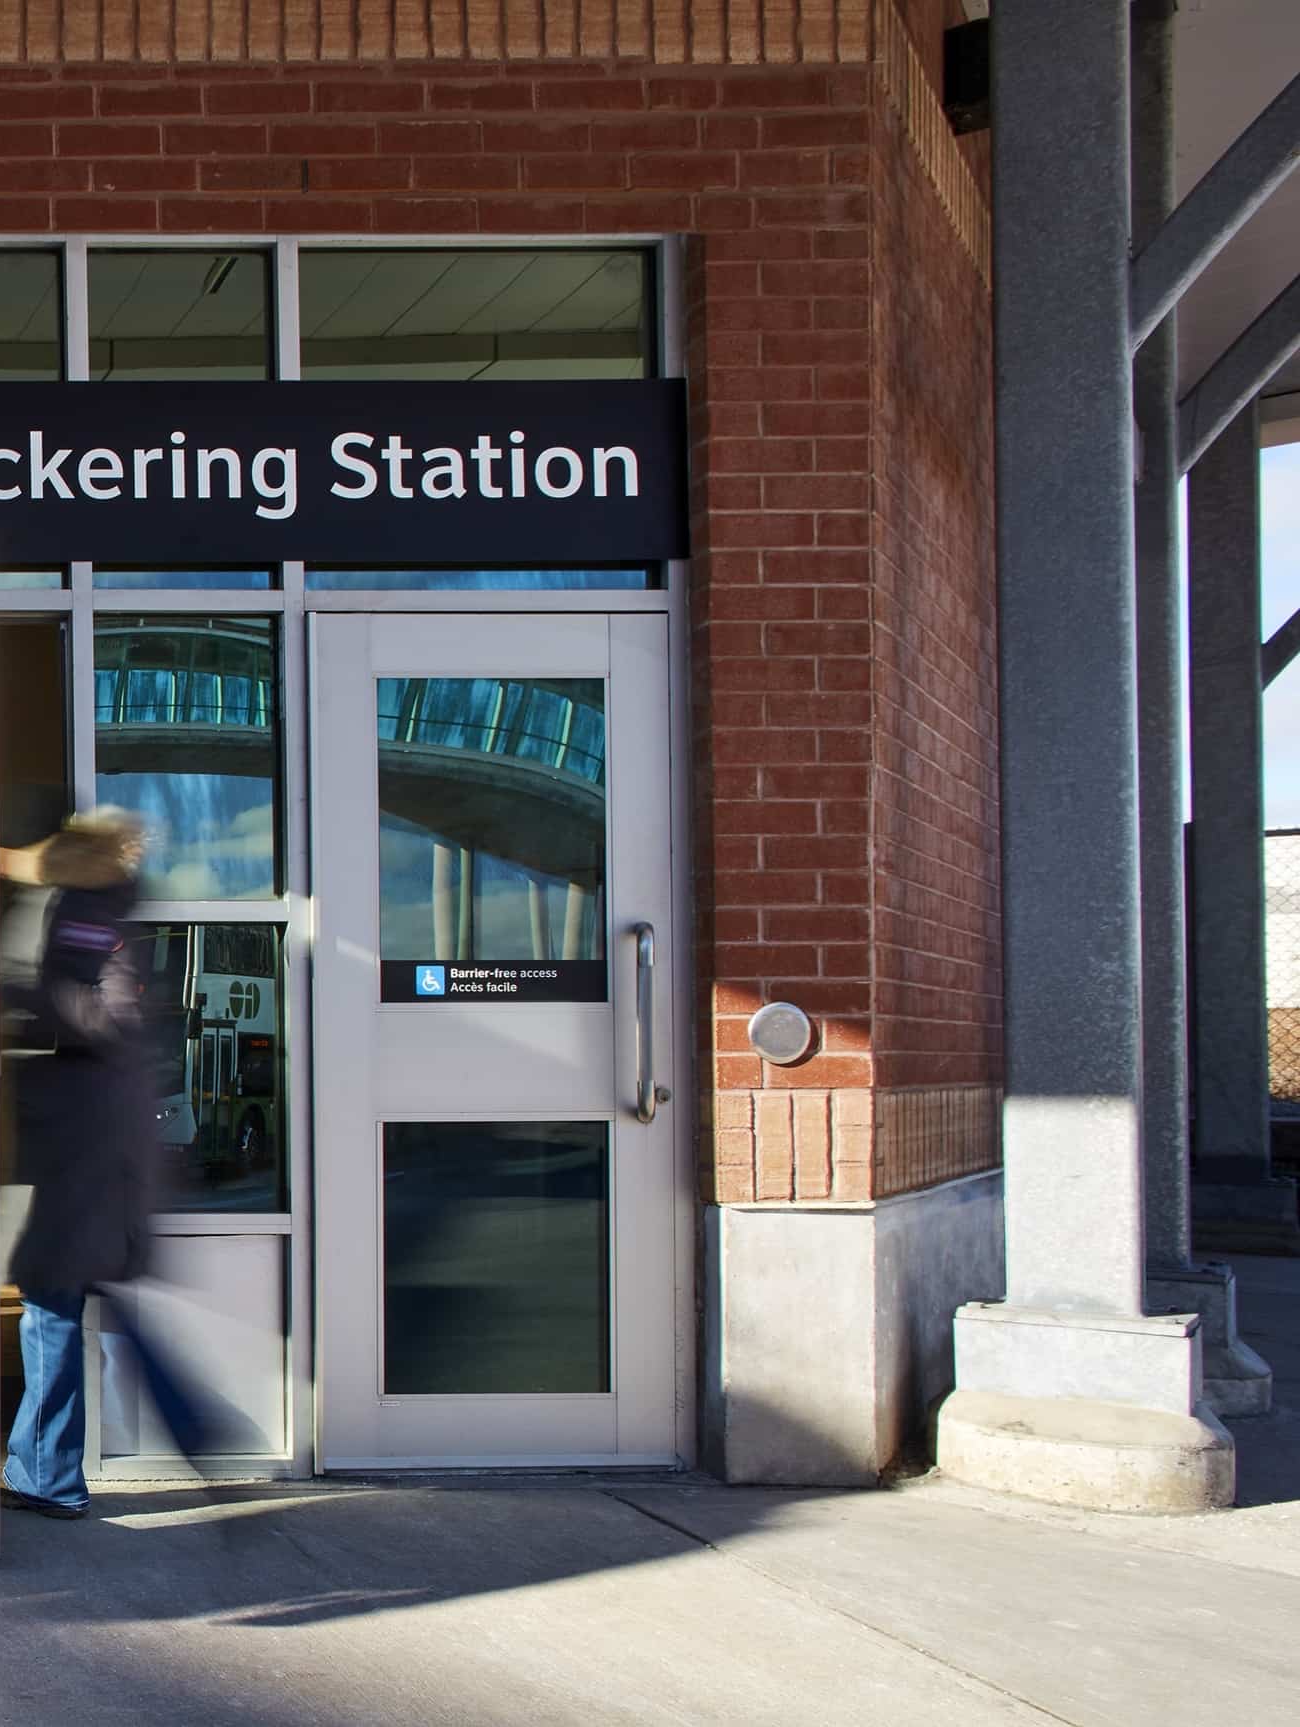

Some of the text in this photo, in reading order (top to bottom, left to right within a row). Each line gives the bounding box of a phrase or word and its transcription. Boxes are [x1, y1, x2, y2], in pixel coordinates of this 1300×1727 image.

[330, 430, 639, 499] Station
[450, 967, 557, 979] Barrier-free access
[449, 981, 518, 993] Accès facile
